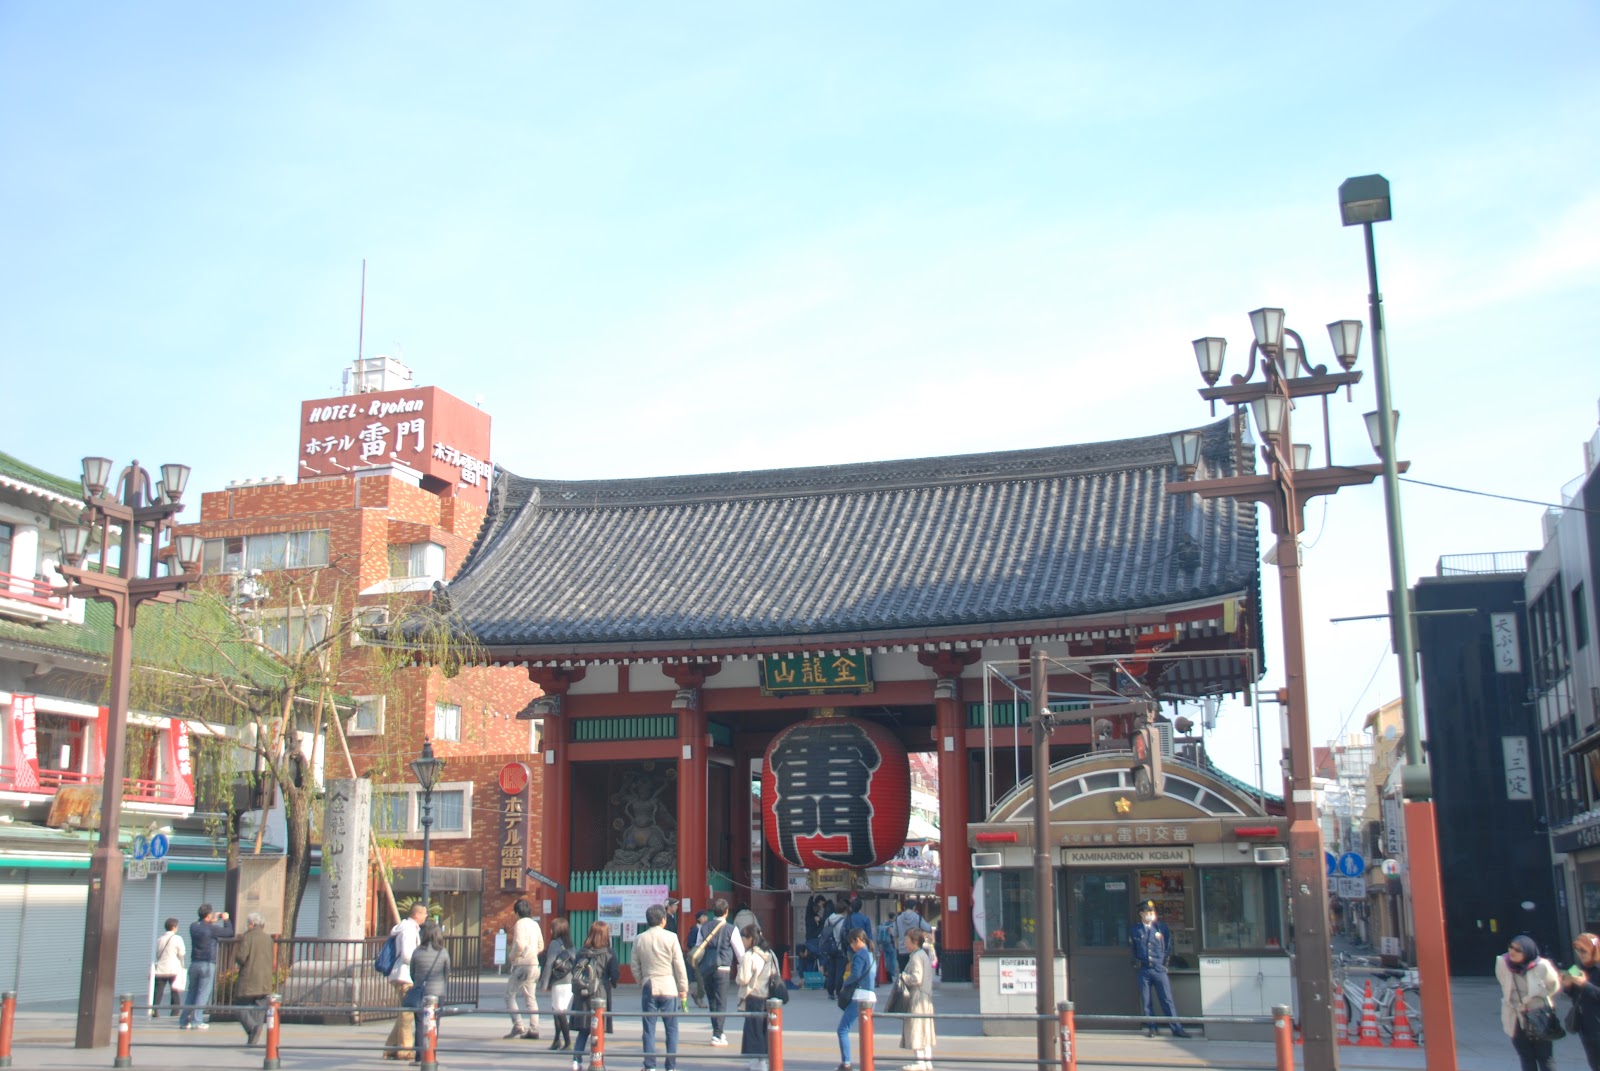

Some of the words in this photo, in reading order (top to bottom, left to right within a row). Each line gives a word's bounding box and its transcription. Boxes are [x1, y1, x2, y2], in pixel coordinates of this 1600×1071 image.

[309, 403, 357, 422] HOTEL
[368, 398, 424, 418] Ryokan
[306, 418, 425, 459] ホテル雷門
[1495, 618, 1513, 667] 天ぷら
[769, 723, 882, 867] 雷門
[500, 796, 524, 889] ホテル雷門
[1117, 826, 1188, 843] 雷門交番
[1072, 851, 1144, 862] KAMINARIMON
[1149, 850, 1184, 861] KOBAN
